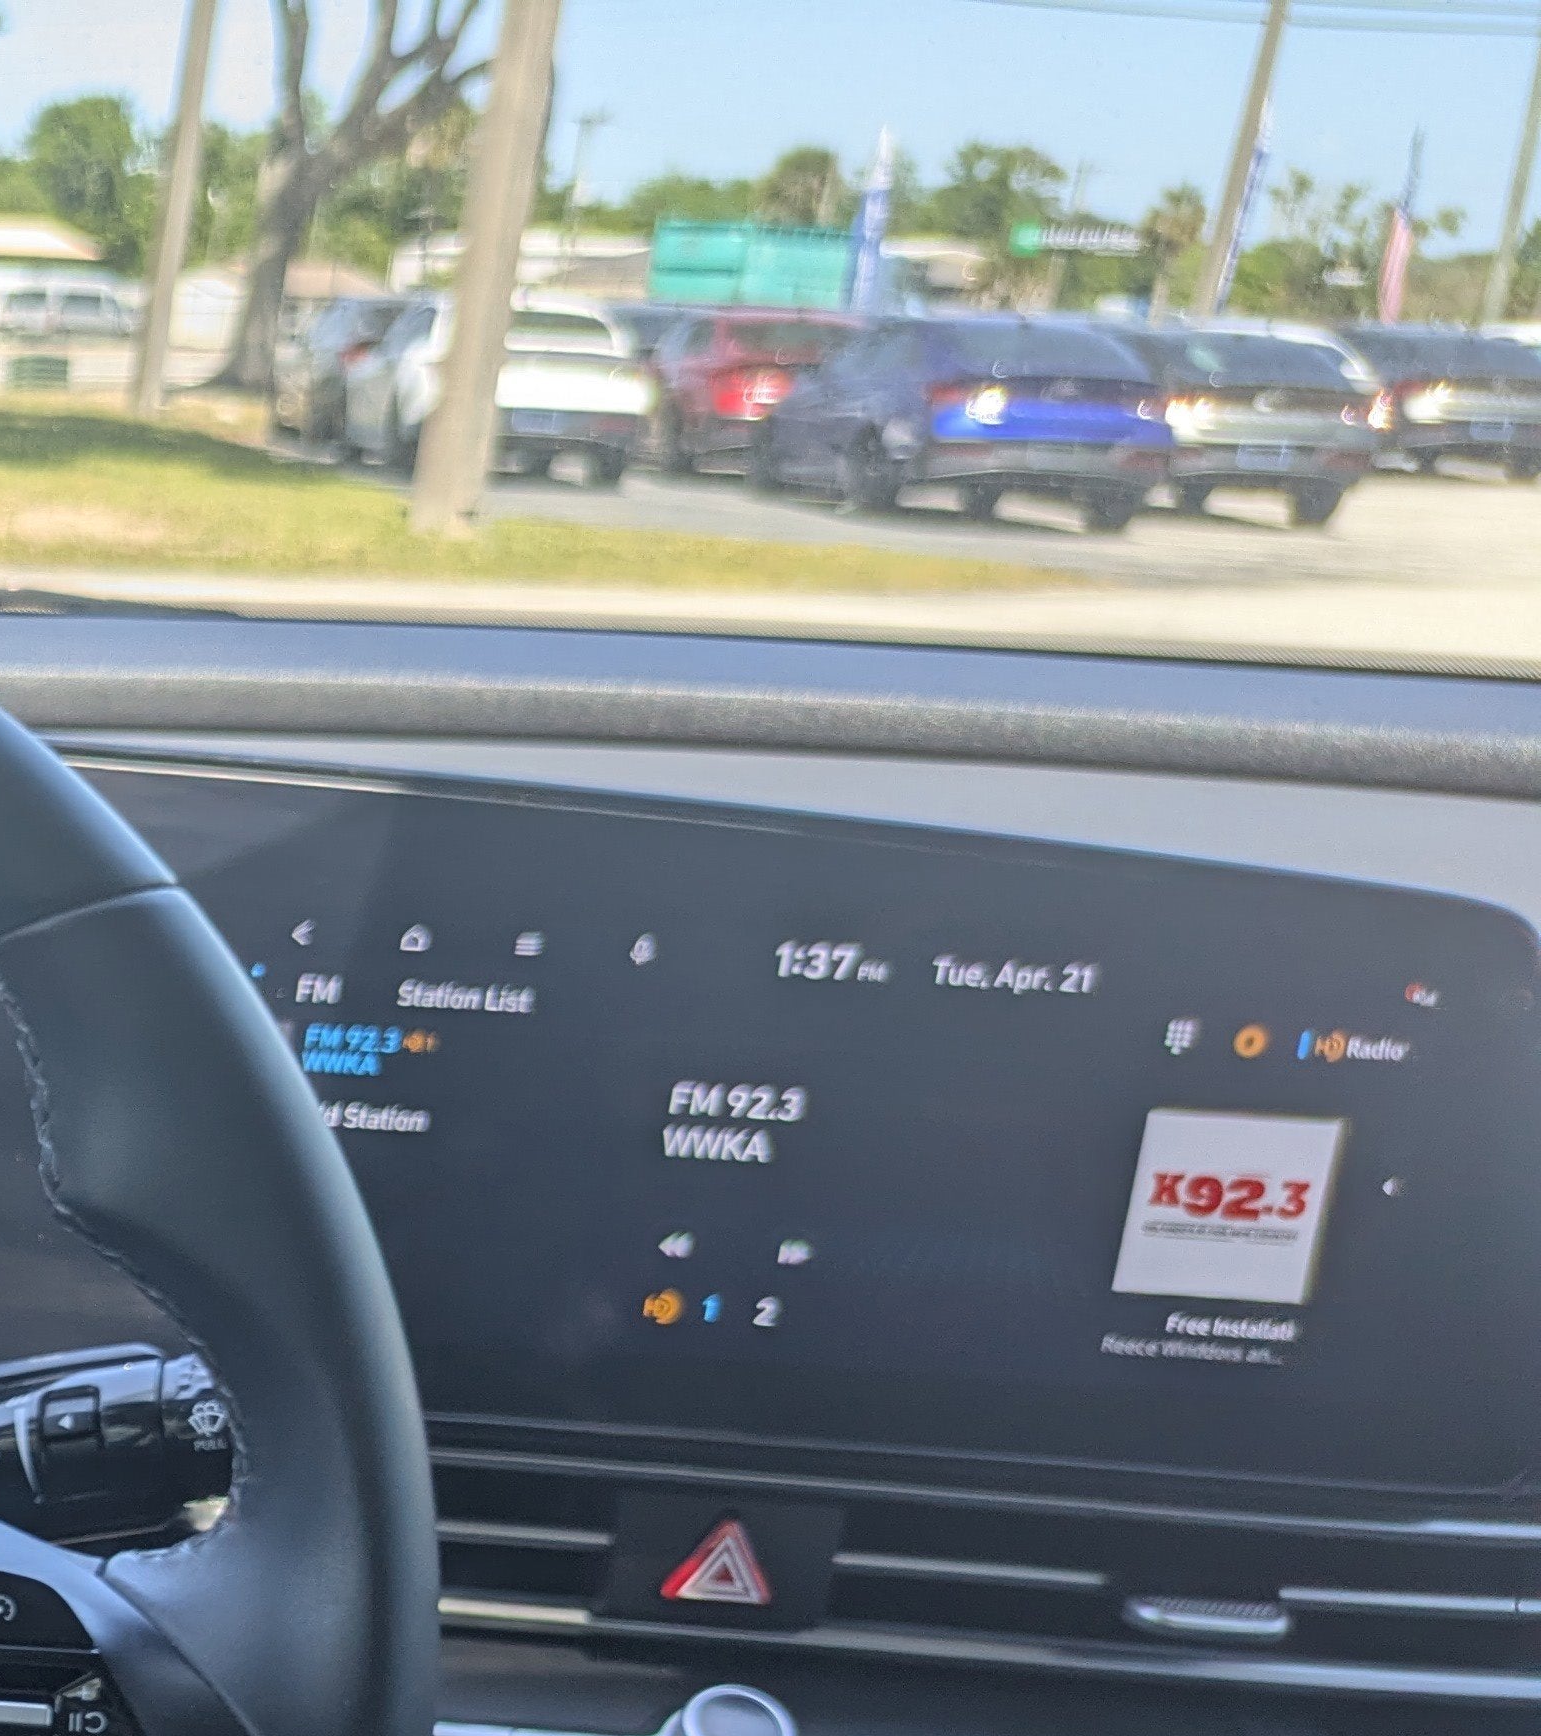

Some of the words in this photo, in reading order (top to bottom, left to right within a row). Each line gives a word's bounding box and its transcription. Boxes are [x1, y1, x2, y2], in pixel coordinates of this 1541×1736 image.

[775, 940, 863, 980] 1:37
[994, 959, 1055, 995] Apr.
[1059, 962, 1100, 993] 21
[295, 973, 344, 1005] FM
[396, 978, 484, 1010] Station
[484, 983, 536, 1014] List
[304, 1022, 346, 1050] FM
[345, 1024, 403, 1053] 92.3
[302, 1050, 382, 1077] WWKA
[343, 1102, 432, 1132] Station
[668, 1080, 726, 1117] FM
[727, 1082, 807, 1122] 92.3
[663, 1123, 773, 1163] WWKA
[1149, 1172, 1310, 1220] K92.3
[702, 1293, 722, 1323] 1
[753, 1296, 782, 1327] 2
